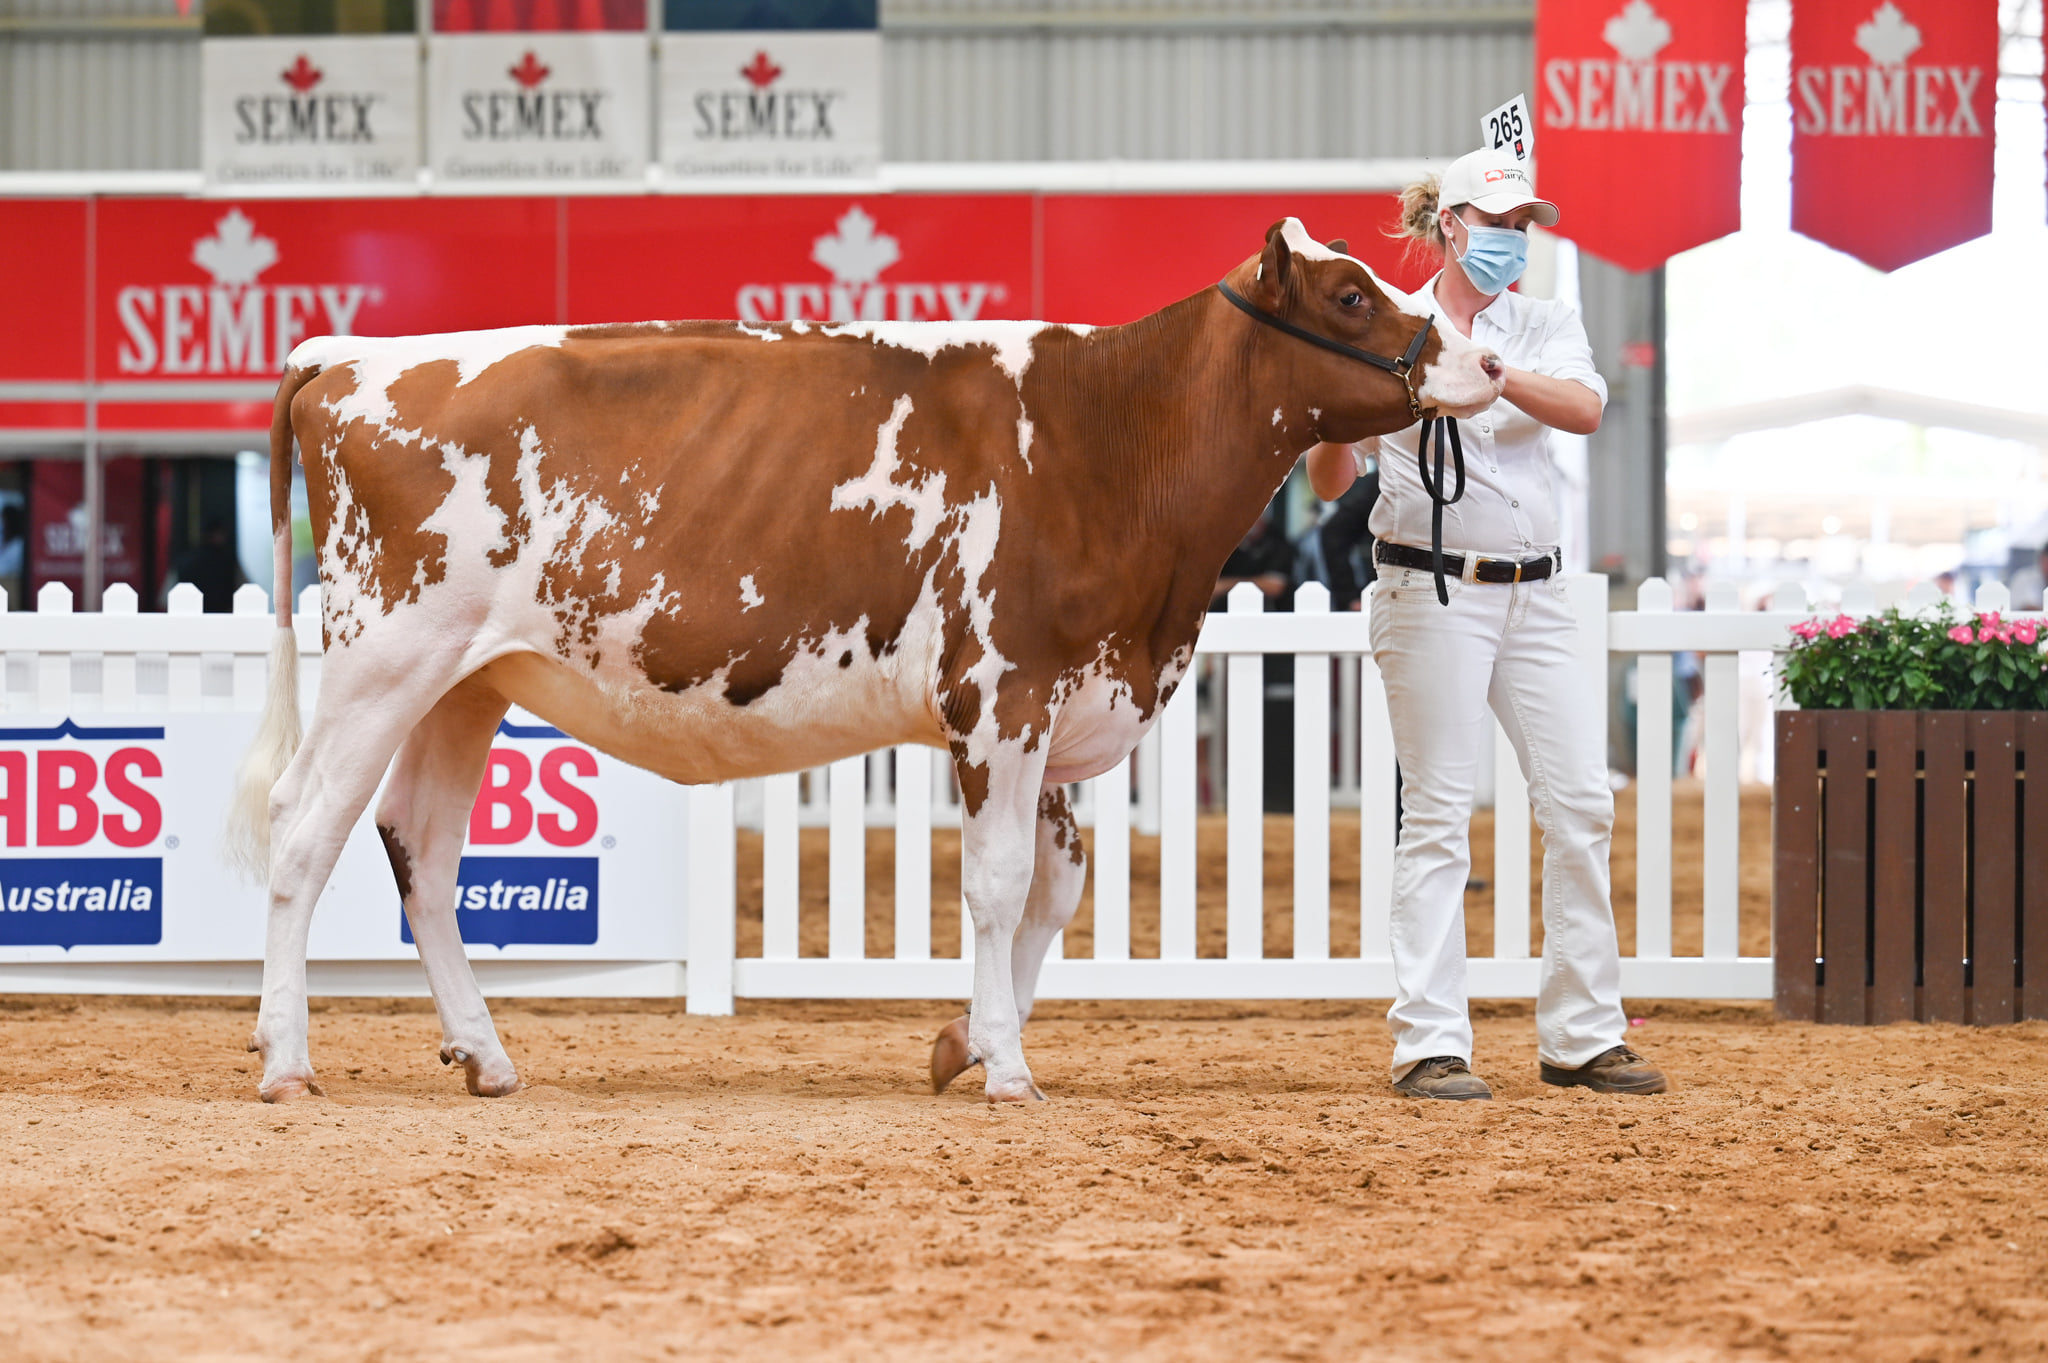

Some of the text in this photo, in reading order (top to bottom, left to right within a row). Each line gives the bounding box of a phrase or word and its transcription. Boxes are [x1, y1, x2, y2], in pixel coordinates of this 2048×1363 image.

[234, 94, 375, 144] SEMEX
[461, 90, 603, 139] SEMEX
[694, 90, 835, 139] SEMEX
[1543, 58, 1733, 134] SEMEX
[1799, 64, 1984, 137] SEMEX
[1490, 104, 1523, 150] 265
[469, 746, 599, 847] BS
[0, 878, 153, 912] ustralia
[455, 878, 589, 911] stralia
